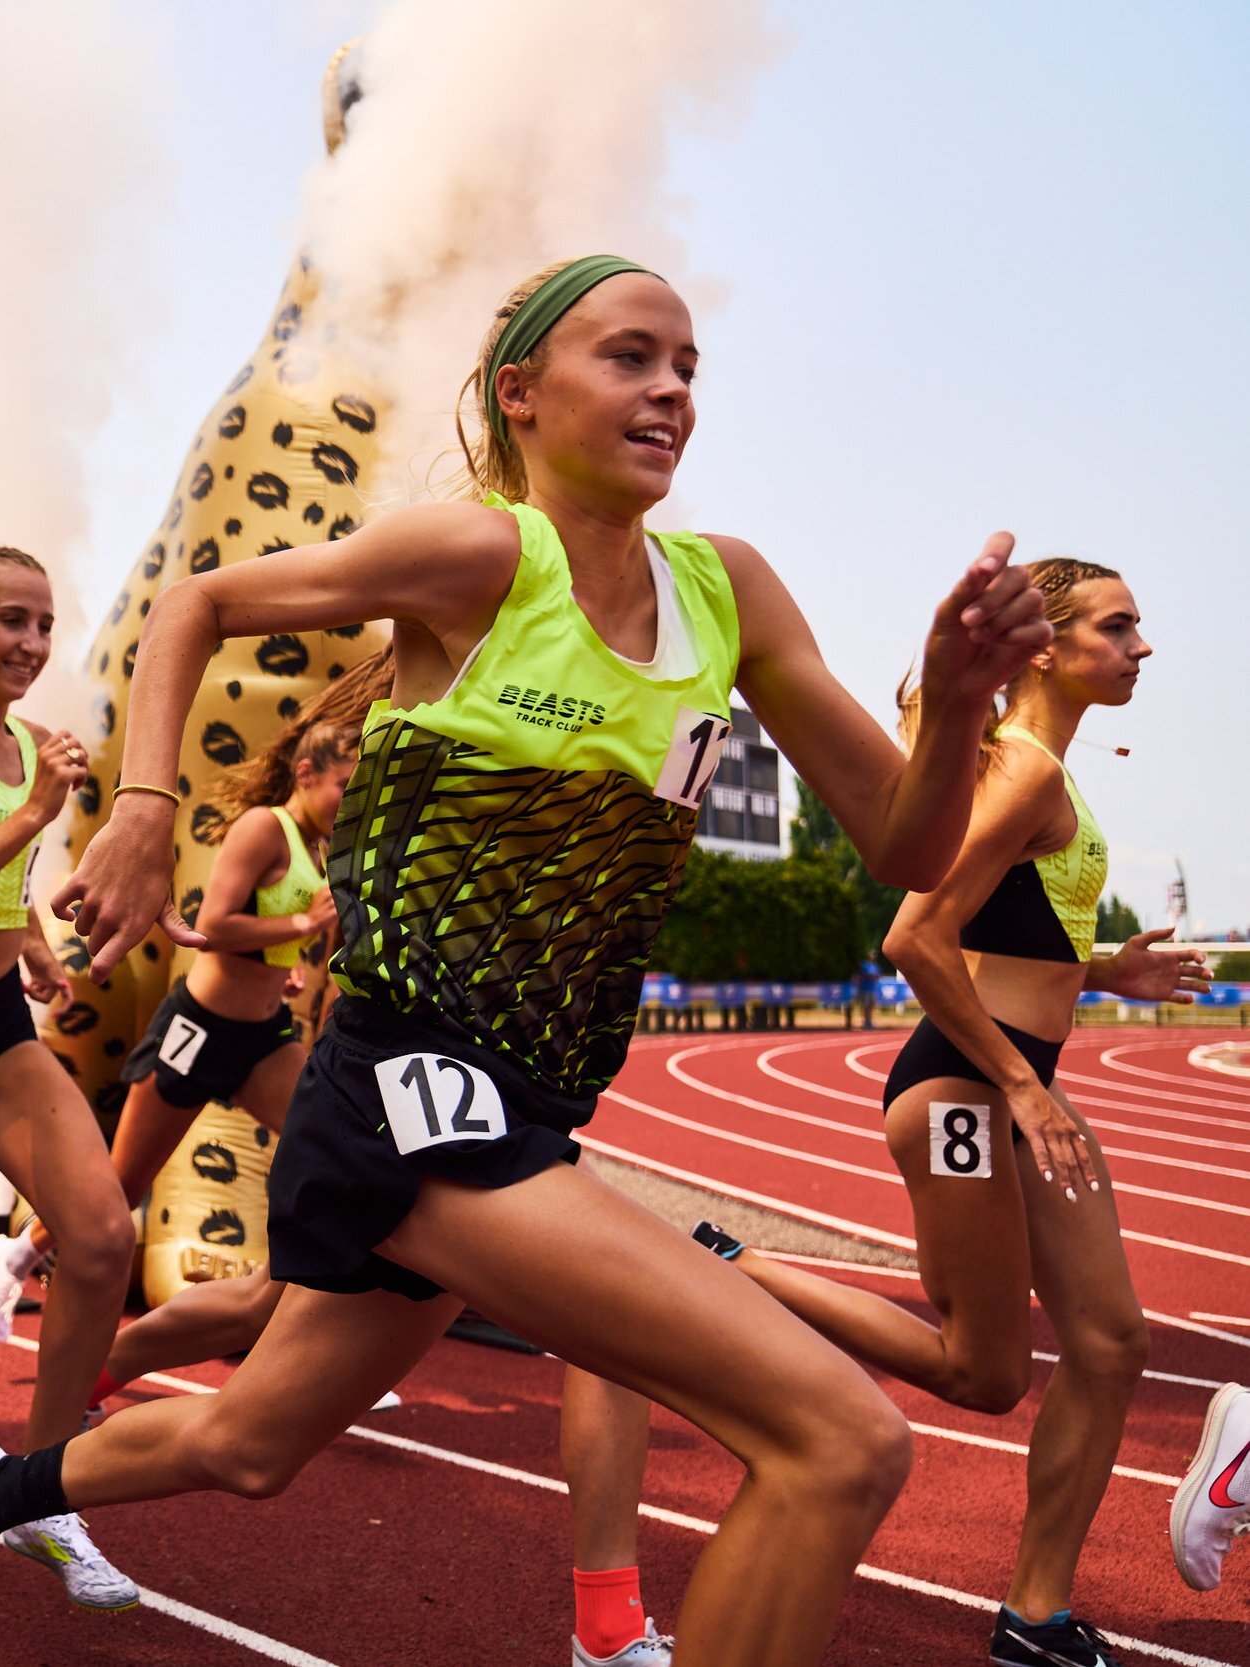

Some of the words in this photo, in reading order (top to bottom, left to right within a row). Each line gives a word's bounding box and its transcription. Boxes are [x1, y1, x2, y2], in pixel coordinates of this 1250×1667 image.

[497, 684, 606, 726] BEASTS
[516, 712, 553, 728] TRACK
[169, 1022, 198, 1061] 7
[399, 1057, 490, 1138] 12
[943, 1107, 981, 1174] 8
